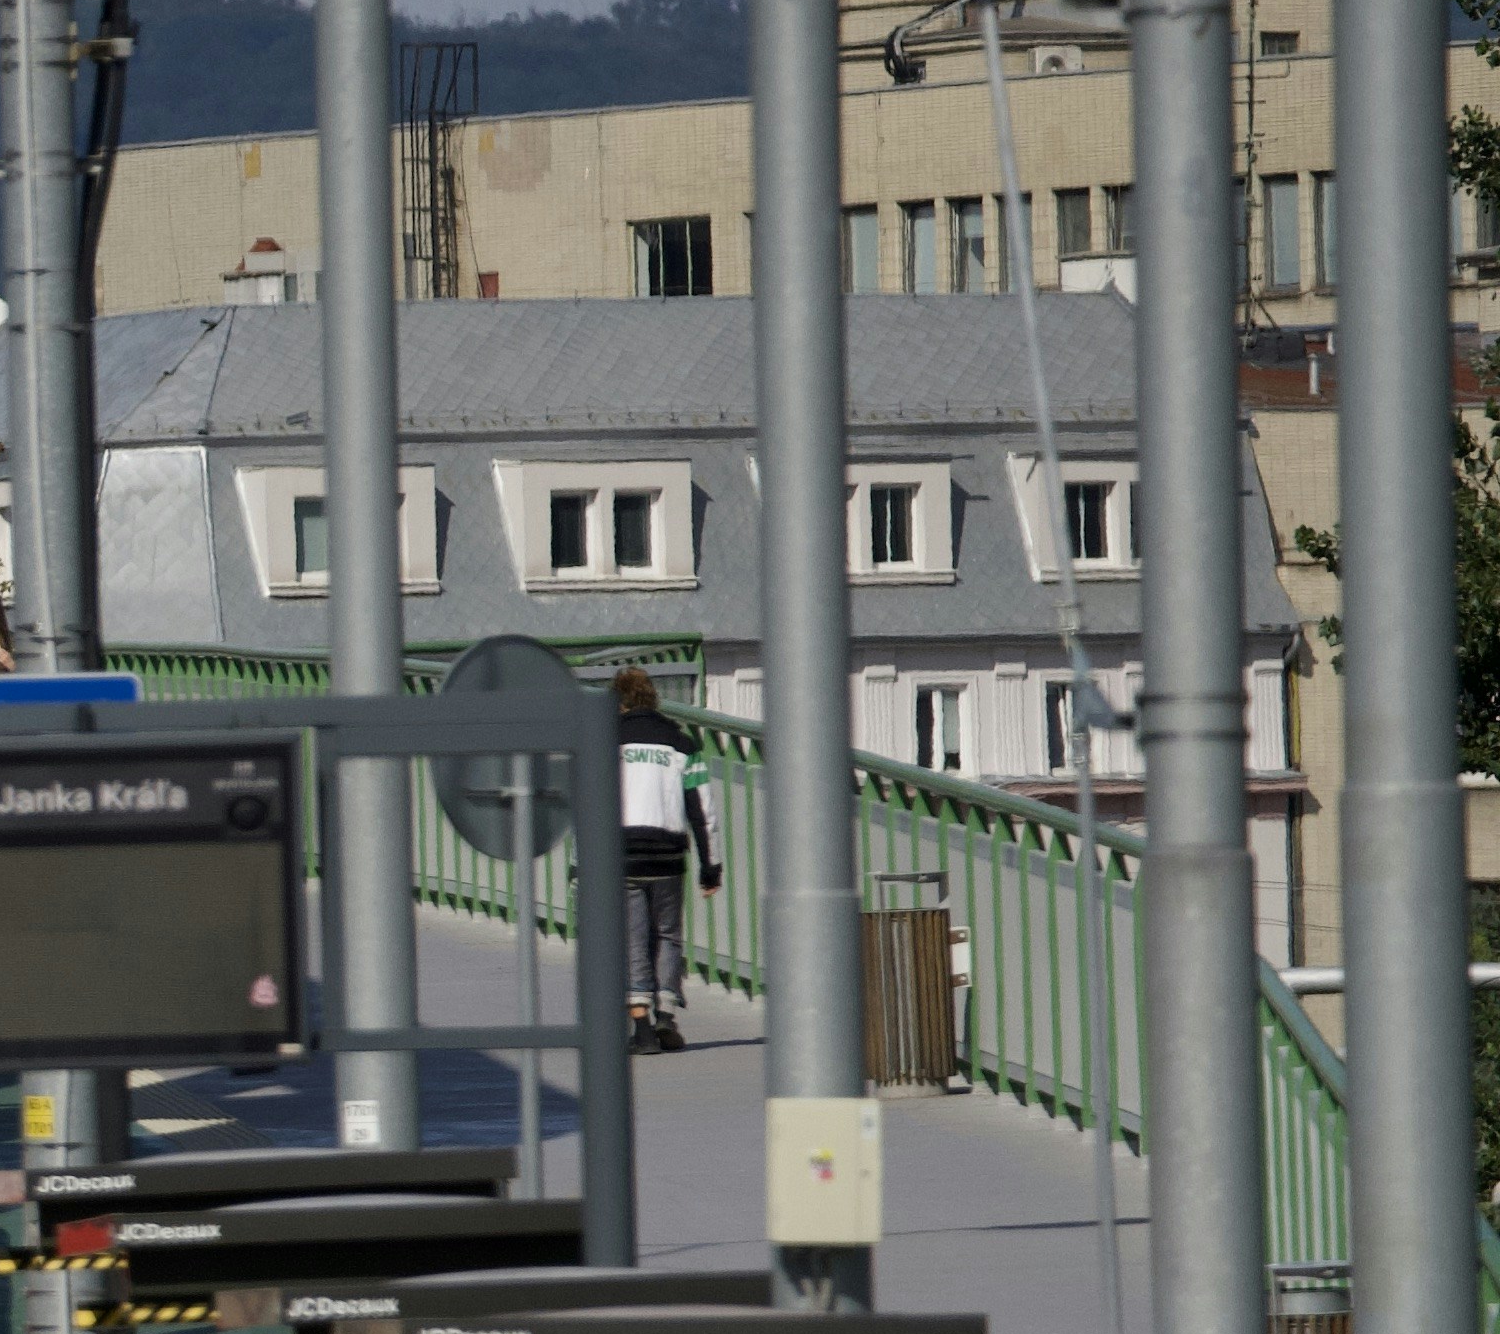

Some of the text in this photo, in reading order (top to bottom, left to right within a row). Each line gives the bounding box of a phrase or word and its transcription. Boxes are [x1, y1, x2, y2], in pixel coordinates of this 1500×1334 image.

[624, 748, 672, 767] SWISS
[36, 1173, 137, 1194] JCDecaux
[117, 1223, 222, 1242] JCDecaux
[288, 1297, 399, 1318] JCDecaux
